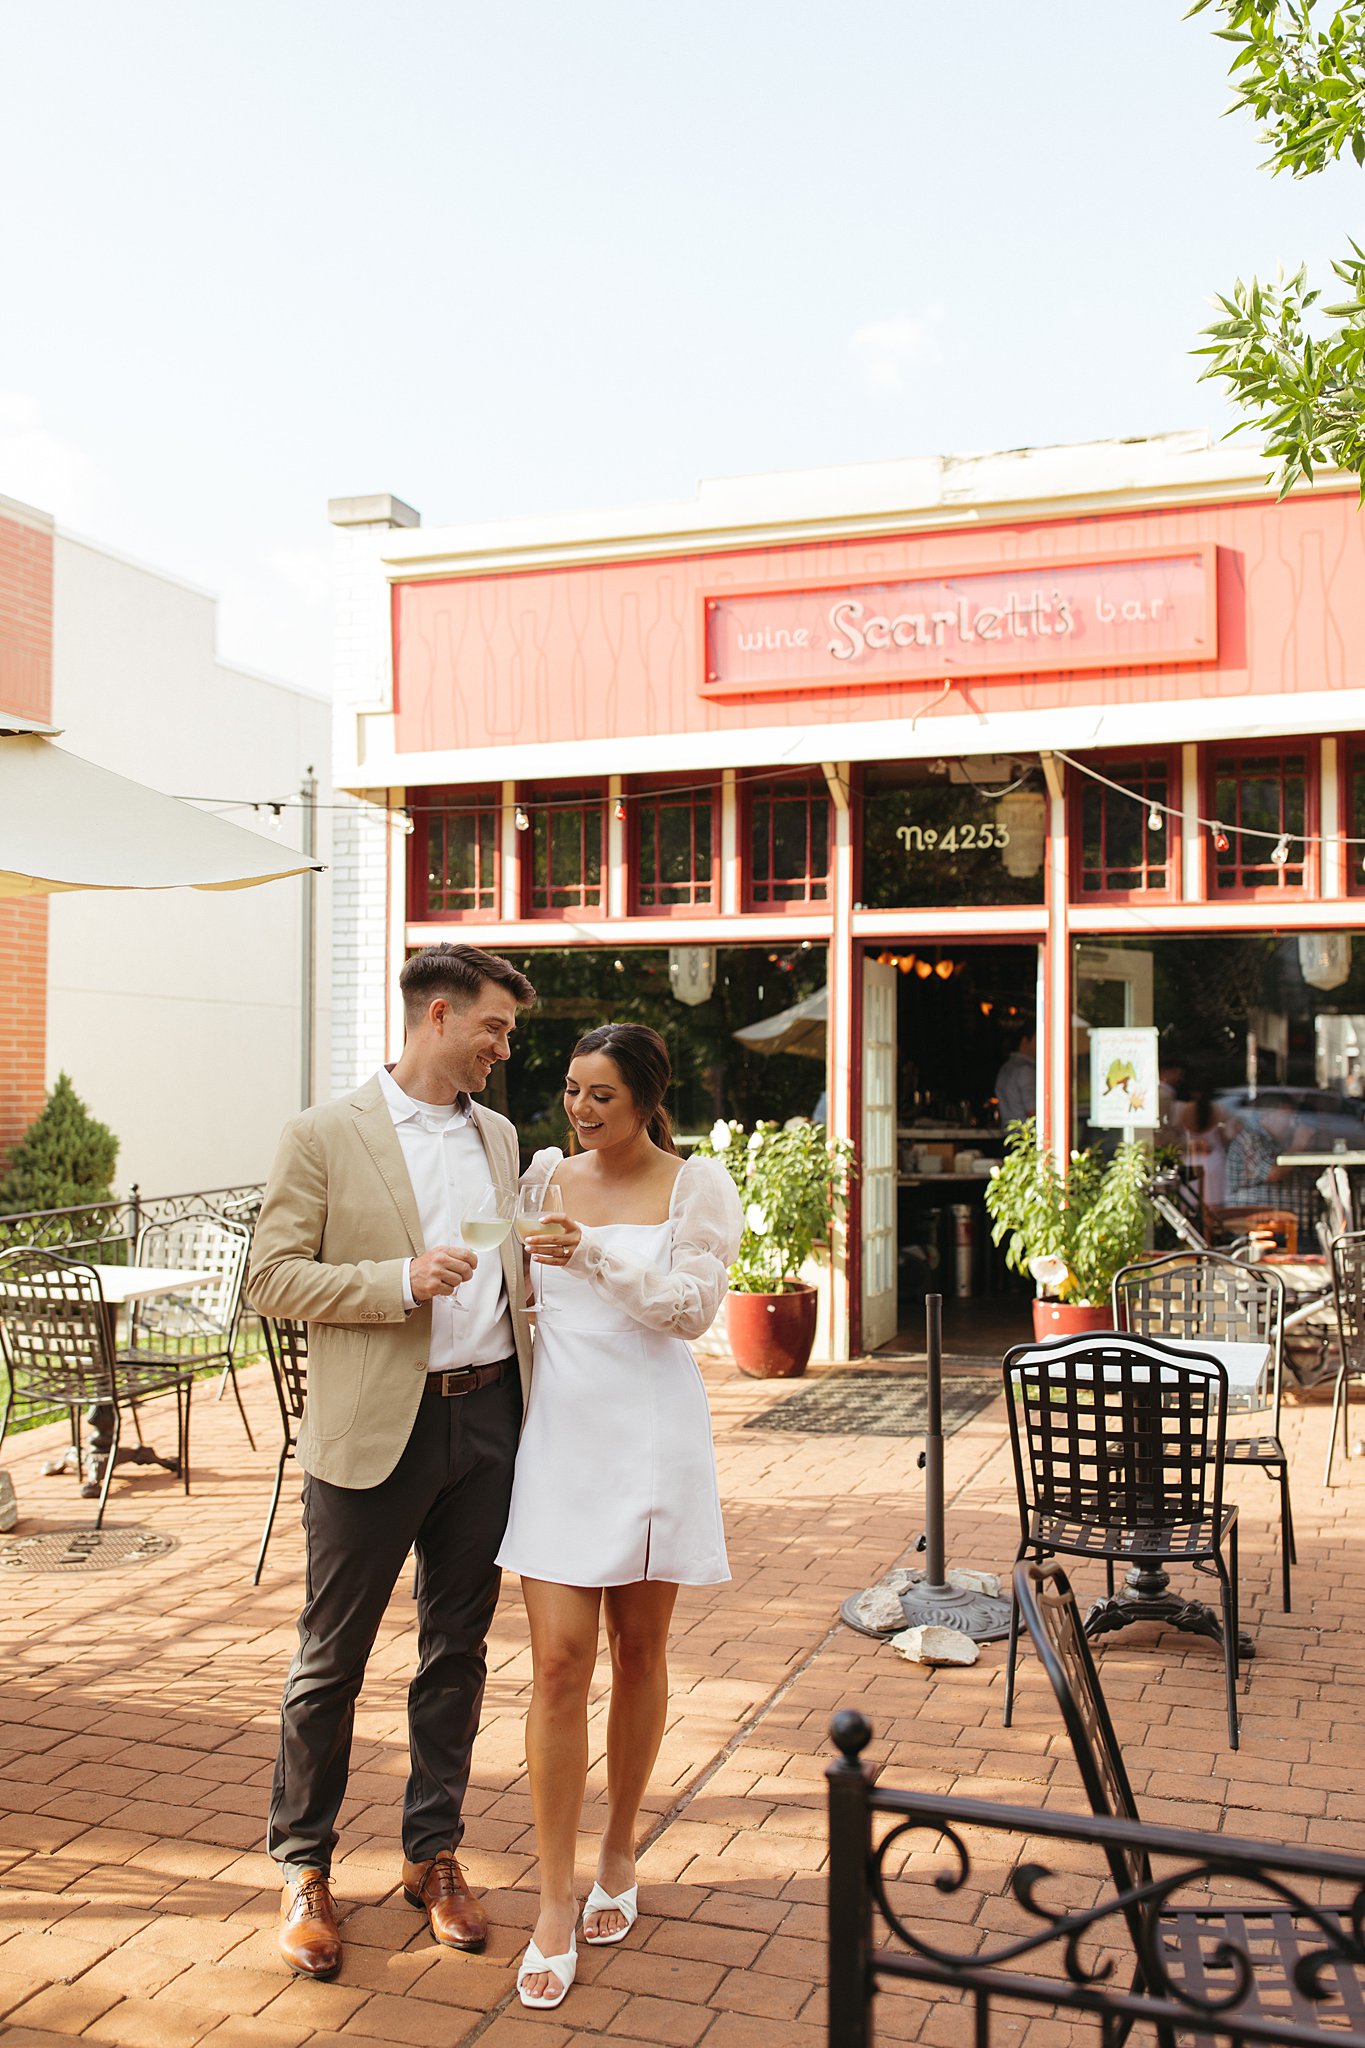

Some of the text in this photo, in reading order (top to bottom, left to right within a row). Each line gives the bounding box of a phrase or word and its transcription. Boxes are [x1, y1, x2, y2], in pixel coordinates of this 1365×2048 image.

[737, 588, 1166, 661] wine Scarlett's bar
